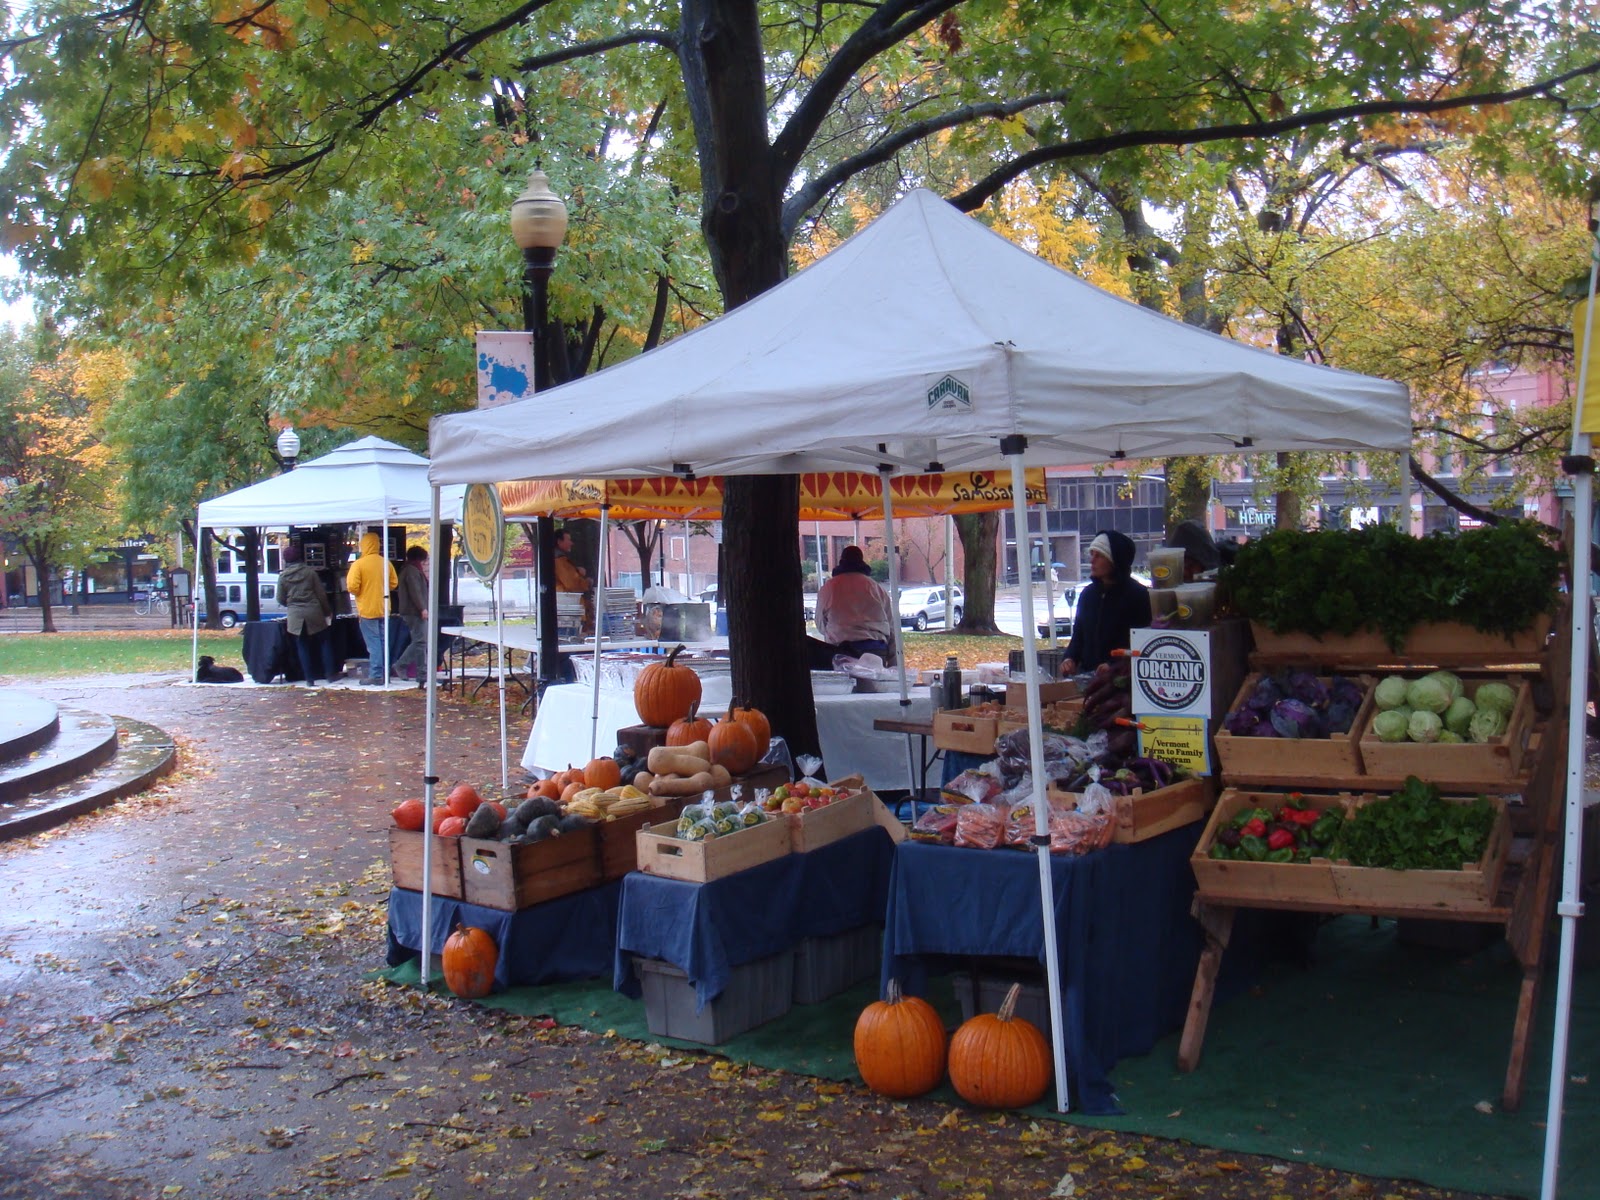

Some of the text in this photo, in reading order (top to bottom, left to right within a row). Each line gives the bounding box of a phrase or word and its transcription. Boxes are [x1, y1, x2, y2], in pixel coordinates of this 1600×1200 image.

[928, 378, 969, 406] CARAVAN
[1155, 652, 1186, 660] VERMONT
[1139, 660, 1203, 681] ORGANIC
[1156, 740, 1190, 748] Vermont
[1175, 749, 1203, 758] Family
[1157, 755, 1191, 764] Program
